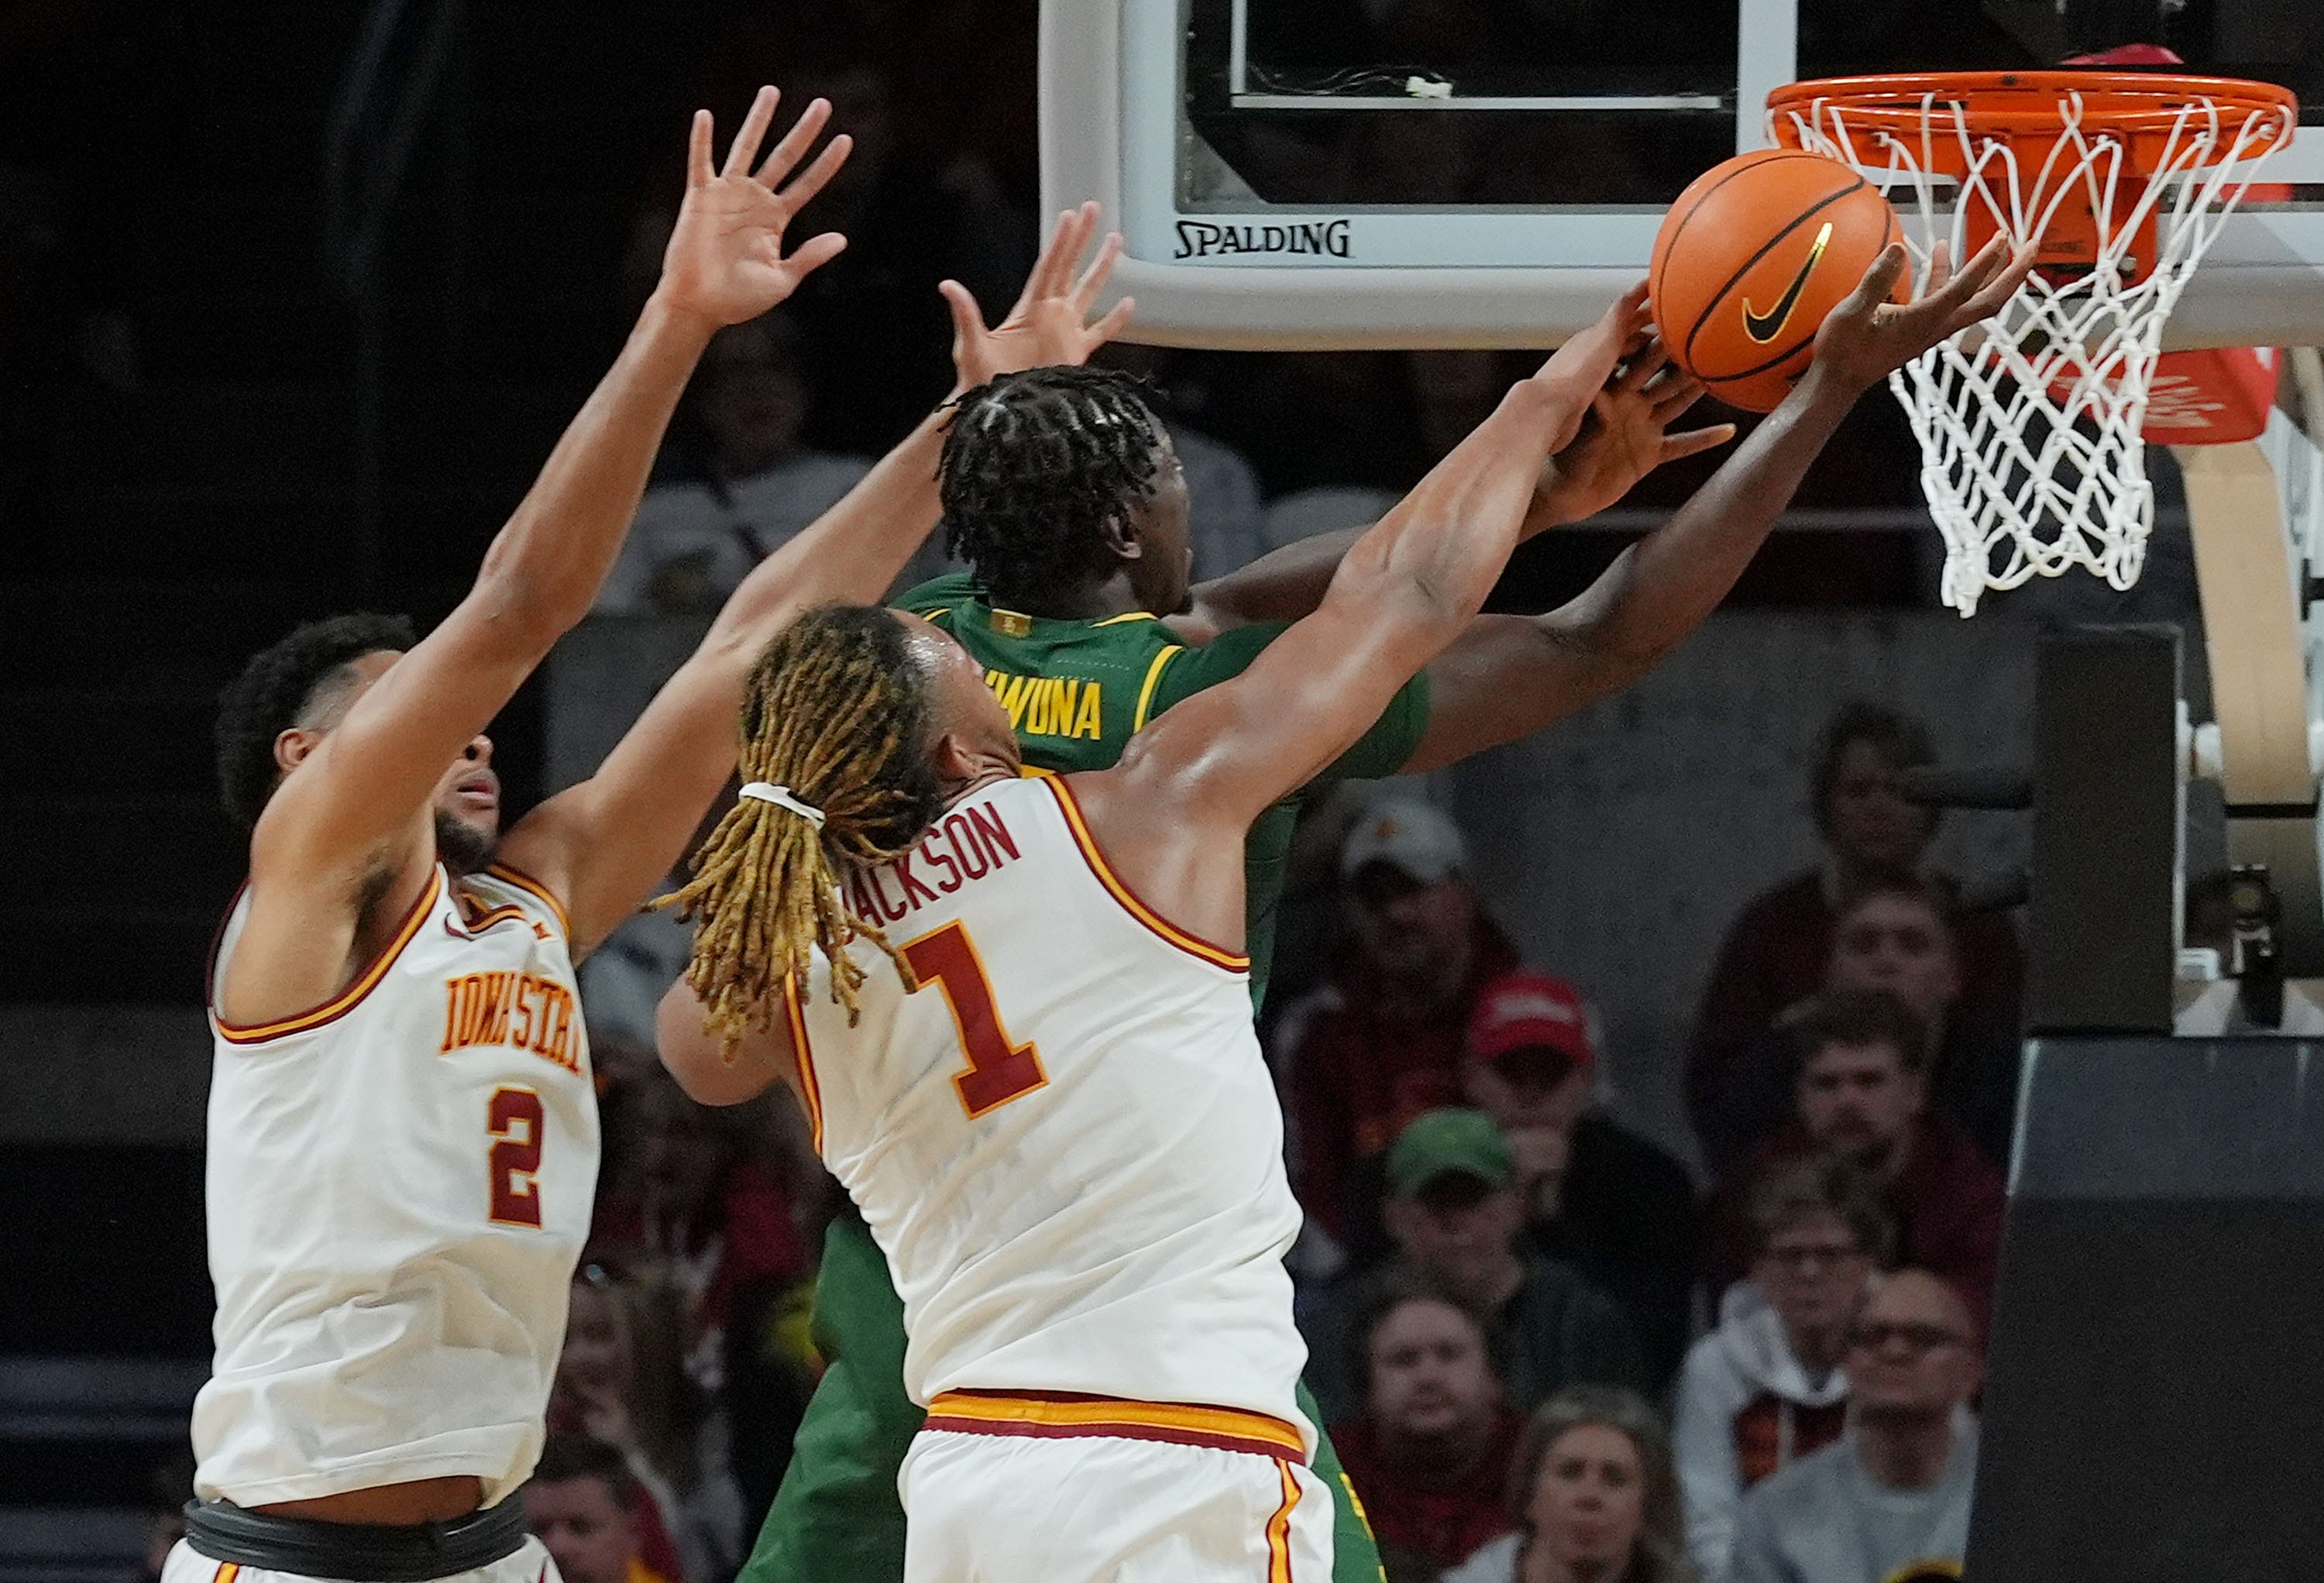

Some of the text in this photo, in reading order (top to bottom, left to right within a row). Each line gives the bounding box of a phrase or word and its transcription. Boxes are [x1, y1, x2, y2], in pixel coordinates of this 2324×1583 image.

[1175, 219, 1351, 259] SPALDING
[985, 669, 1102, 740] WUNA
[842, 801, 1021, 945] ACKSON
[898, 918, 1050, 1120] 1
[487, 1087, 545, 1229] 2
